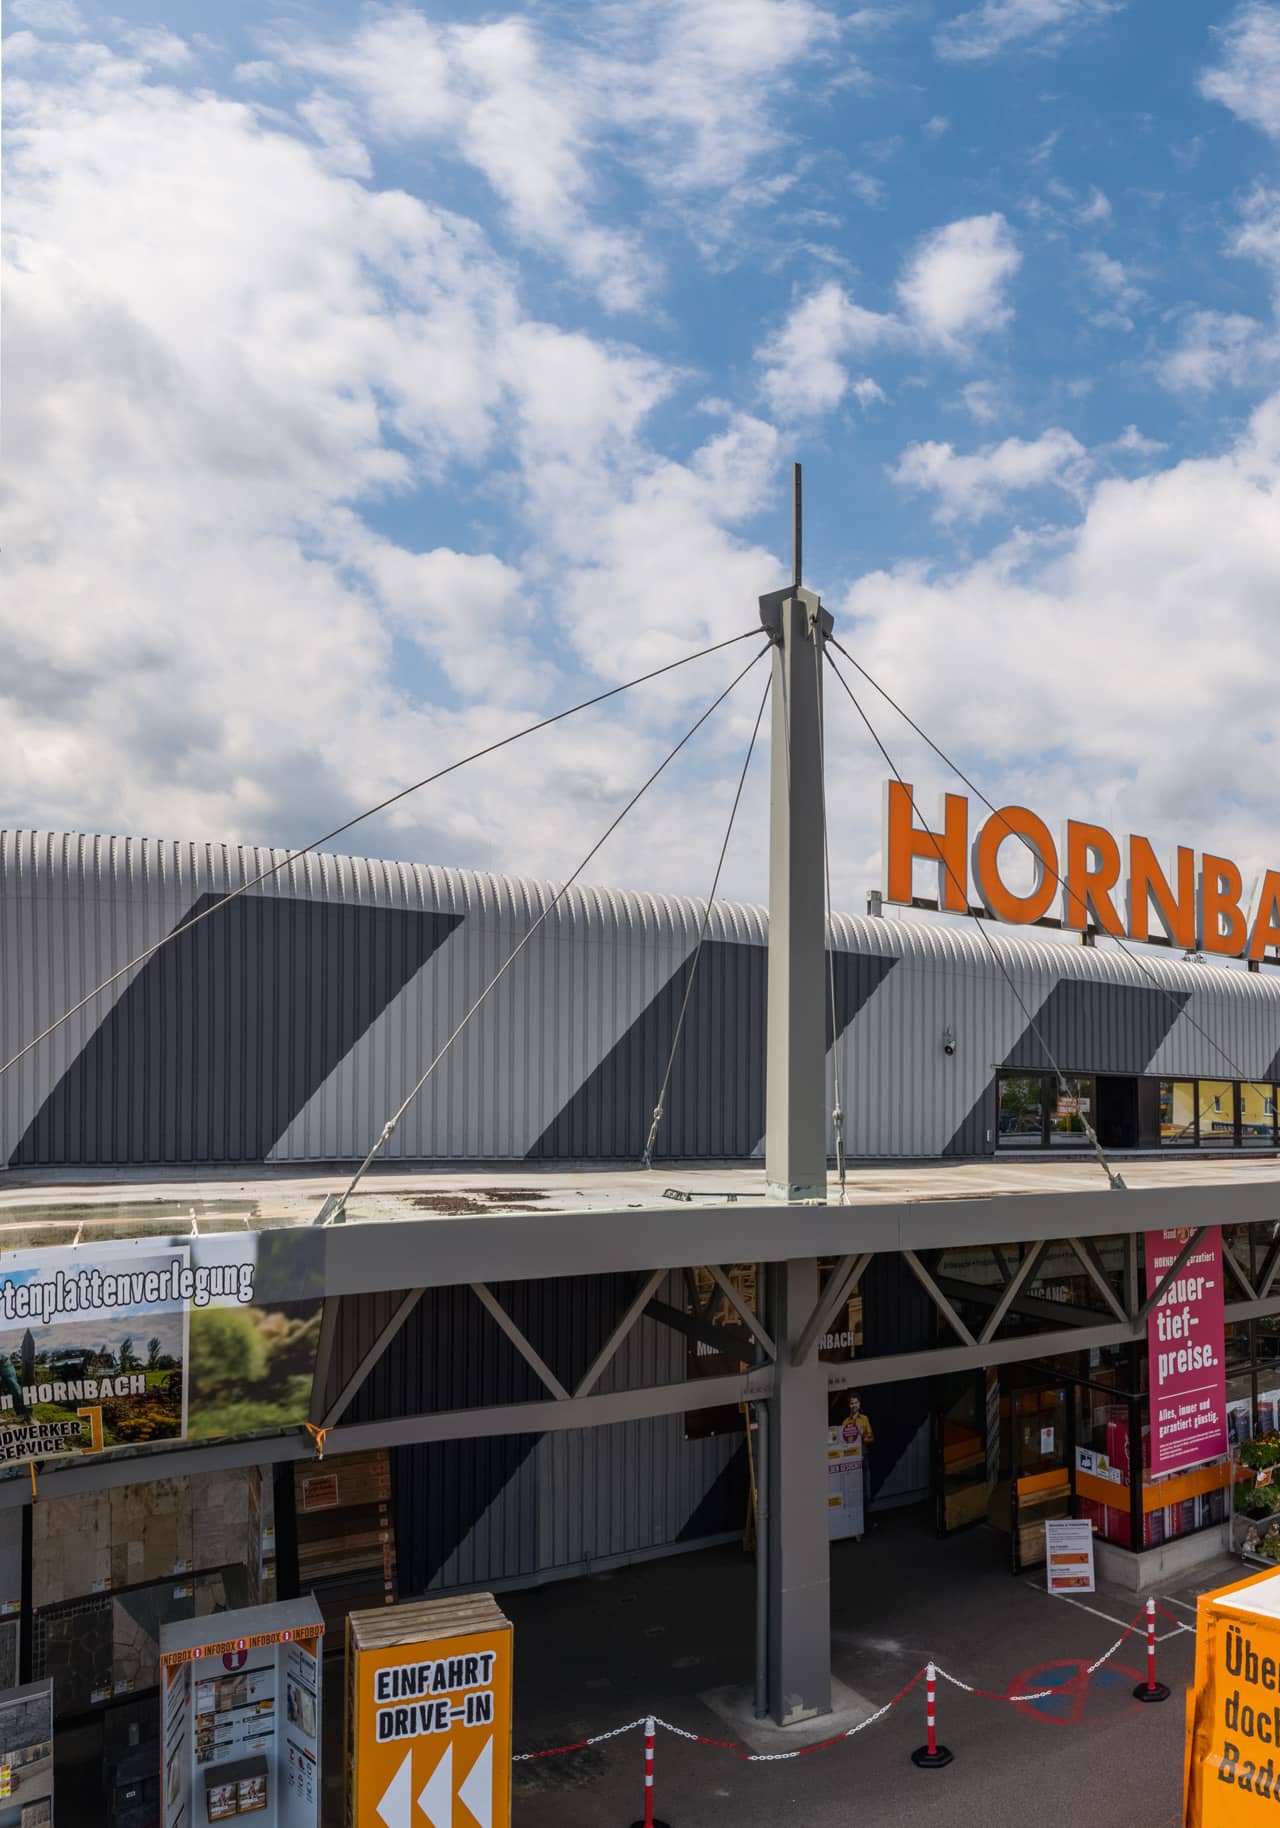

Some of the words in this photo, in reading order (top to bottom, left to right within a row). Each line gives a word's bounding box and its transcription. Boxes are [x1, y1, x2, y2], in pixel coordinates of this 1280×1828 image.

[1154, 1255, 1177, 1269] HORNBA
[0, 1260, 254, 1323] tenplattenverlegung
[818, 1331, 855, 1350] NBACH
[1157, 1306, 1199, 1341] tief-
[1158, 1340, 1218, 1385] preise.
[22, 1374, 146, 1405] HORNBACH
[1158, 1408, 1177, 1421] Alles,
[1178, 1404, 1198, 1417] immer
[1158, 1417, 1193, 1439] garantiert
[160, 1650, 192, 1666] INFOBOX
[204, 1641, 236, 1657] INFOBOX
[249, 1632, 281, 1648] INFOBOX
[292, 1624, 325, 1641] INFOBOX
[376, 1652, 495, 1701] EINFAHRT
[377, 1693, 493, 1740] DRIVE-IN
